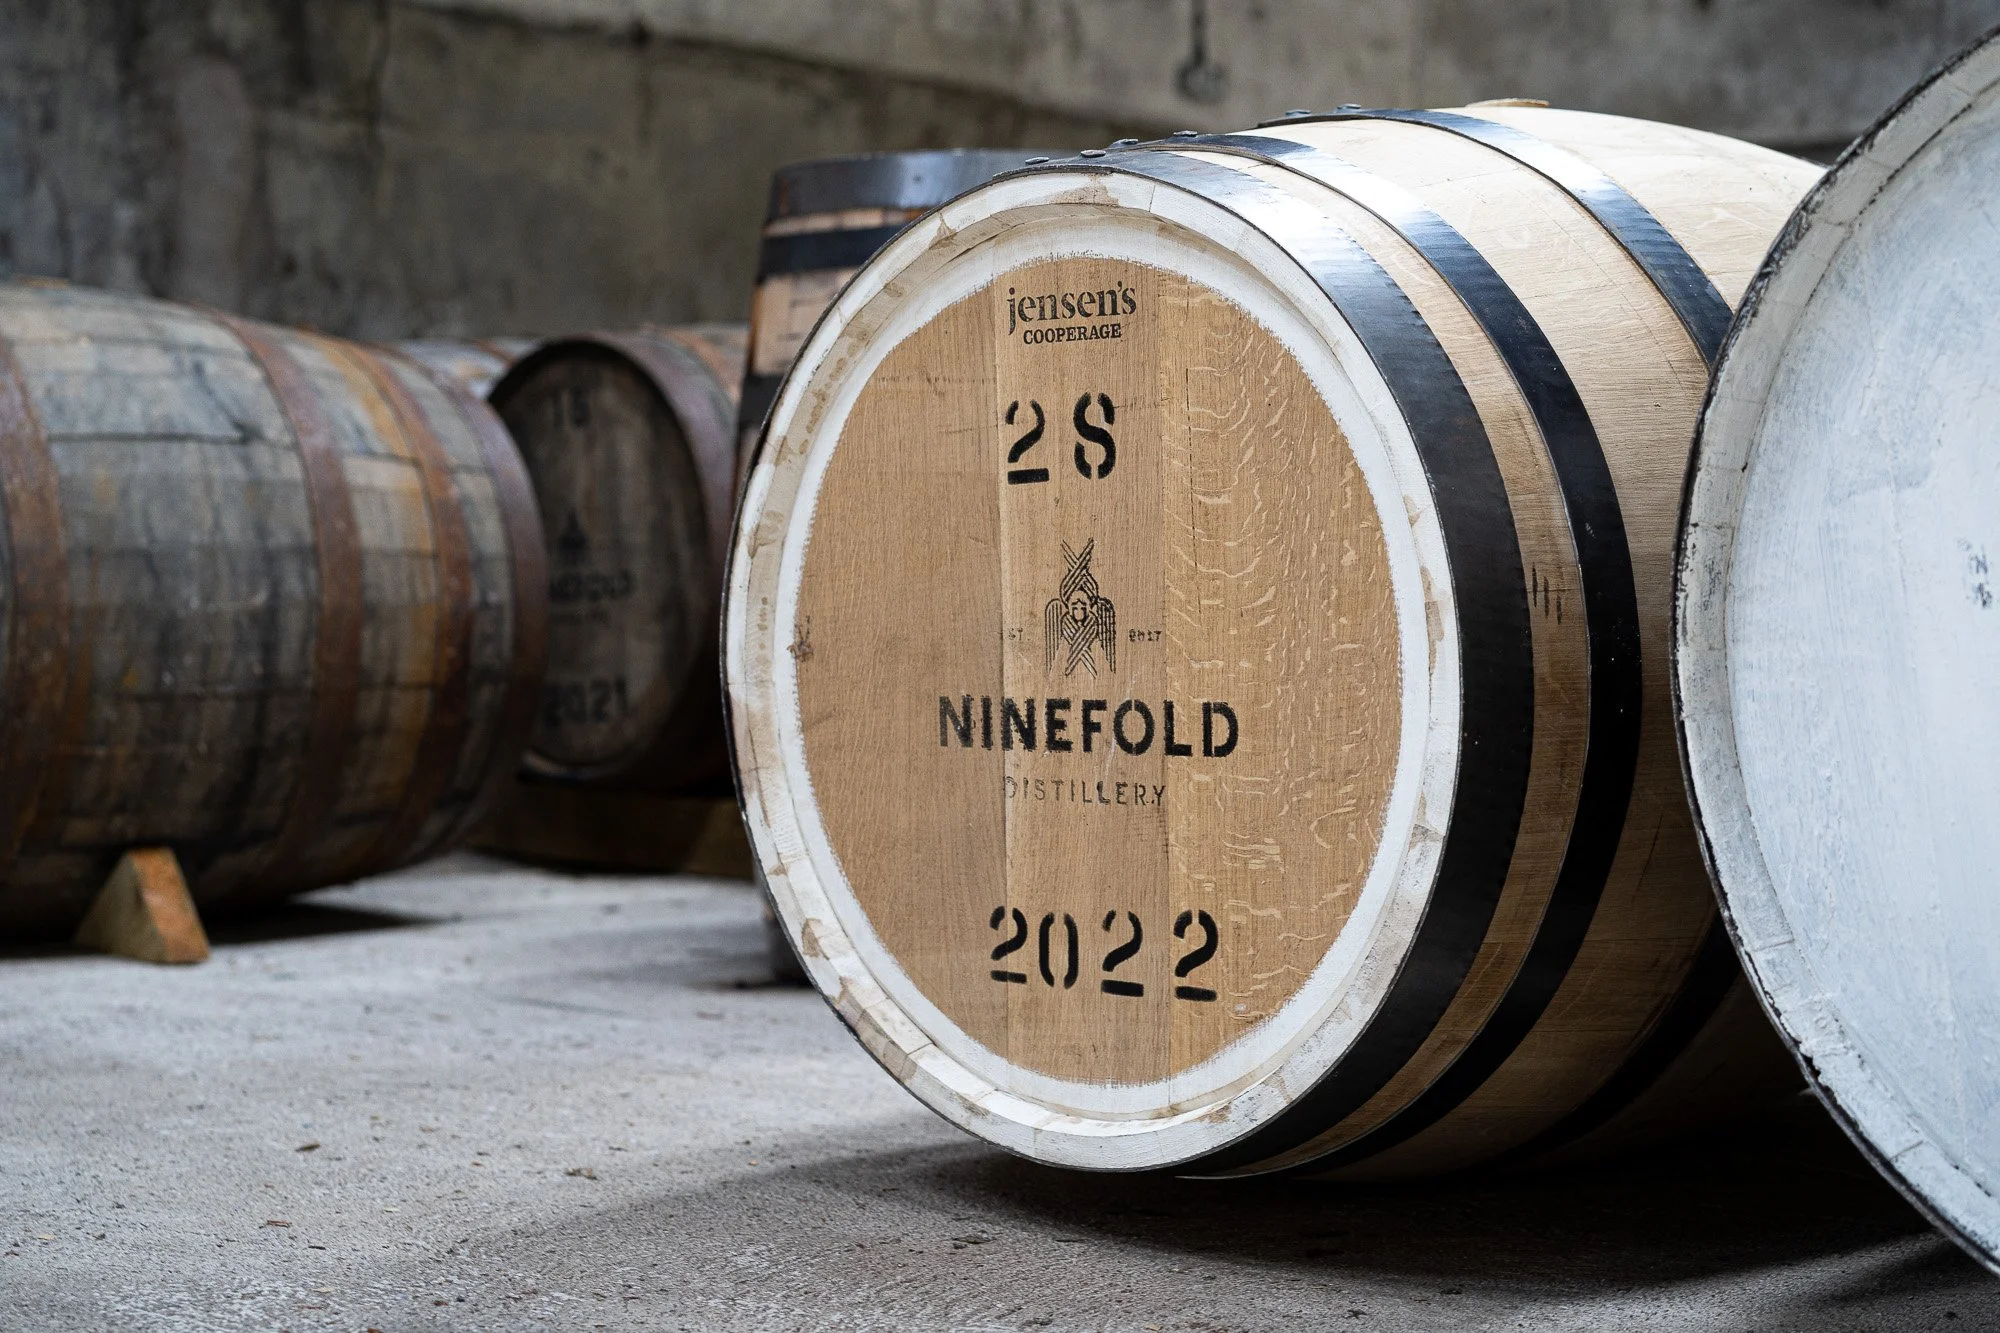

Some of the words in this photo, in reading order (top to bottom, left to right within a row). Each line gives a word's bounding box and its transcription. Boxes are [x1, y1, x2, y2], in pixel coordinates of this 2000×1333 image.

[1007, 281, 1137, 335] jensen's
[1023, 323, 1122, 344] COOPERAGE
[939, 694, 1239, 757] NINEFOLD
[1002, 775, 1166, 806] DISTILLERY
[990, 905, 1218, 1003] 2022
